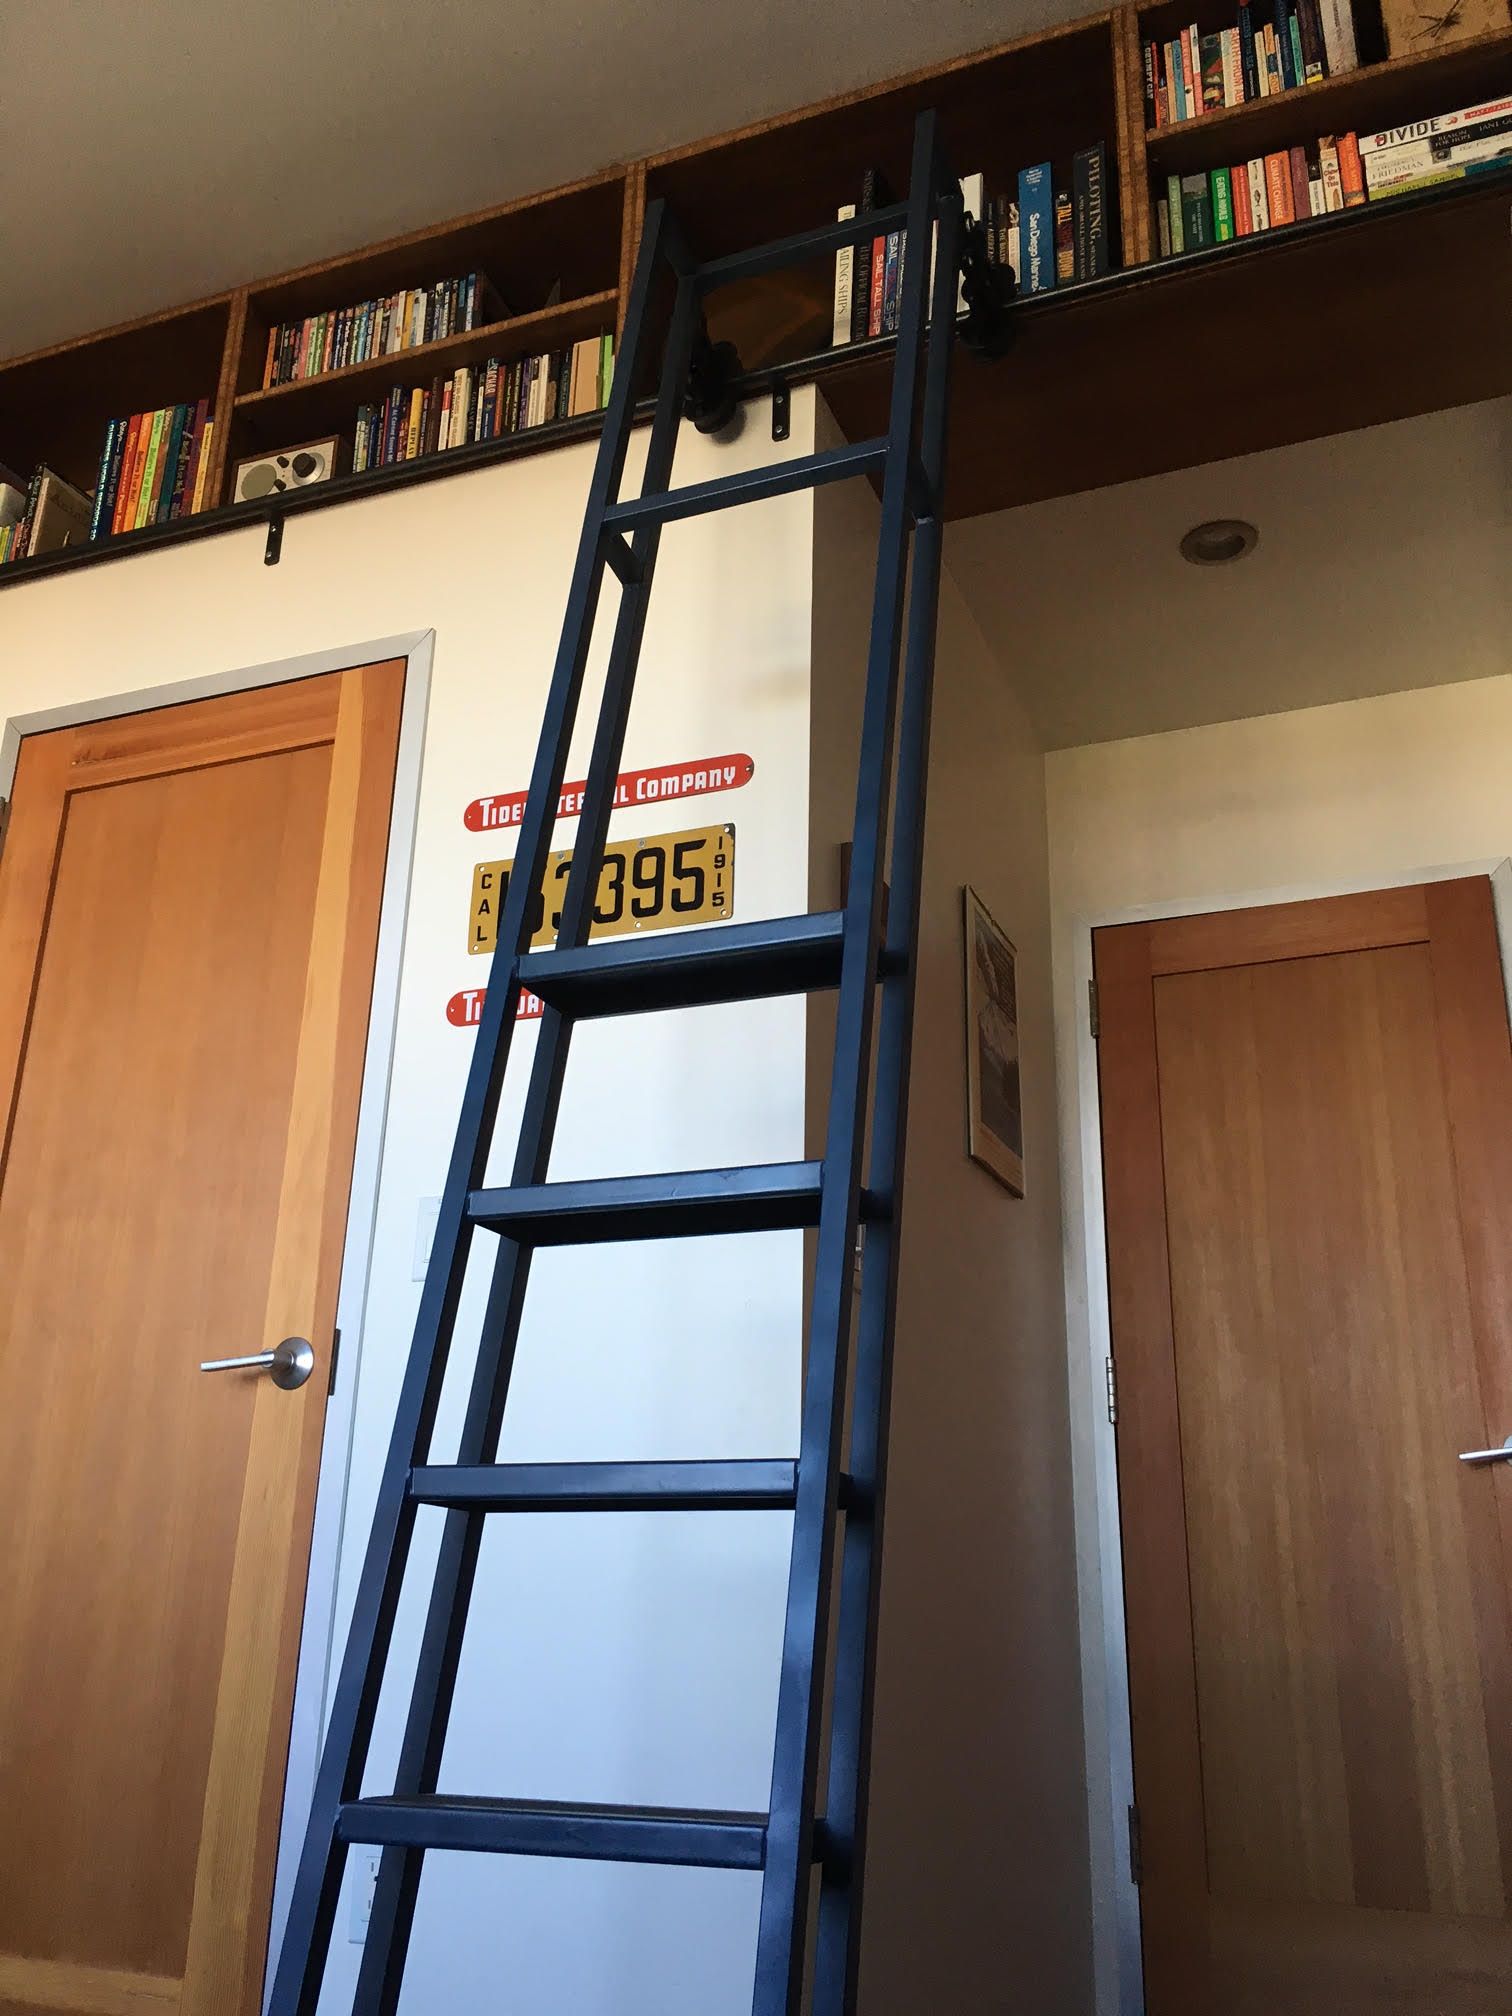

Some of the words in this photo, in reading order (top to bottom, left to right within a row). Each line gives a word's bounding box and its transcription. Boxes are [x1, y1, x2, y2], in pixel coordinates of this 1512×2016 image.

[1144, 47, 1153, 81] GRUMPY
[1375, 118, 1441, 147] DIVIDE
[1270, 159, 1281, 190] CLIMATE
[1057, 203, 1073, 225] TALL
[1087, 153, 1102, 245] PILOTING,
[1273, 190, 1284, 220] CHANGE
[1030, 213, 1041, 230] San
[887, 235, 898, 265] SAIL
[1028, 230, 1041, 257] Diego
[838, 249, 850, 282] AILING
[875, 254, 884, 279] SAIL
[1058, 249, 1075, 280] DOWN
[1079, 257, 1087, 280] HAND
[1089, 245, 1097, 278] SEAMAN
[838, 284, 849, 315] SHIPS
[874, 279, 883, 307] TALL
[485, 366, 499, 396] SACHAR
[408, 427, 417, 455] REPLAY
[98, 462, 109, 490] WORLD
[712, 835, 727, 908] 1915
